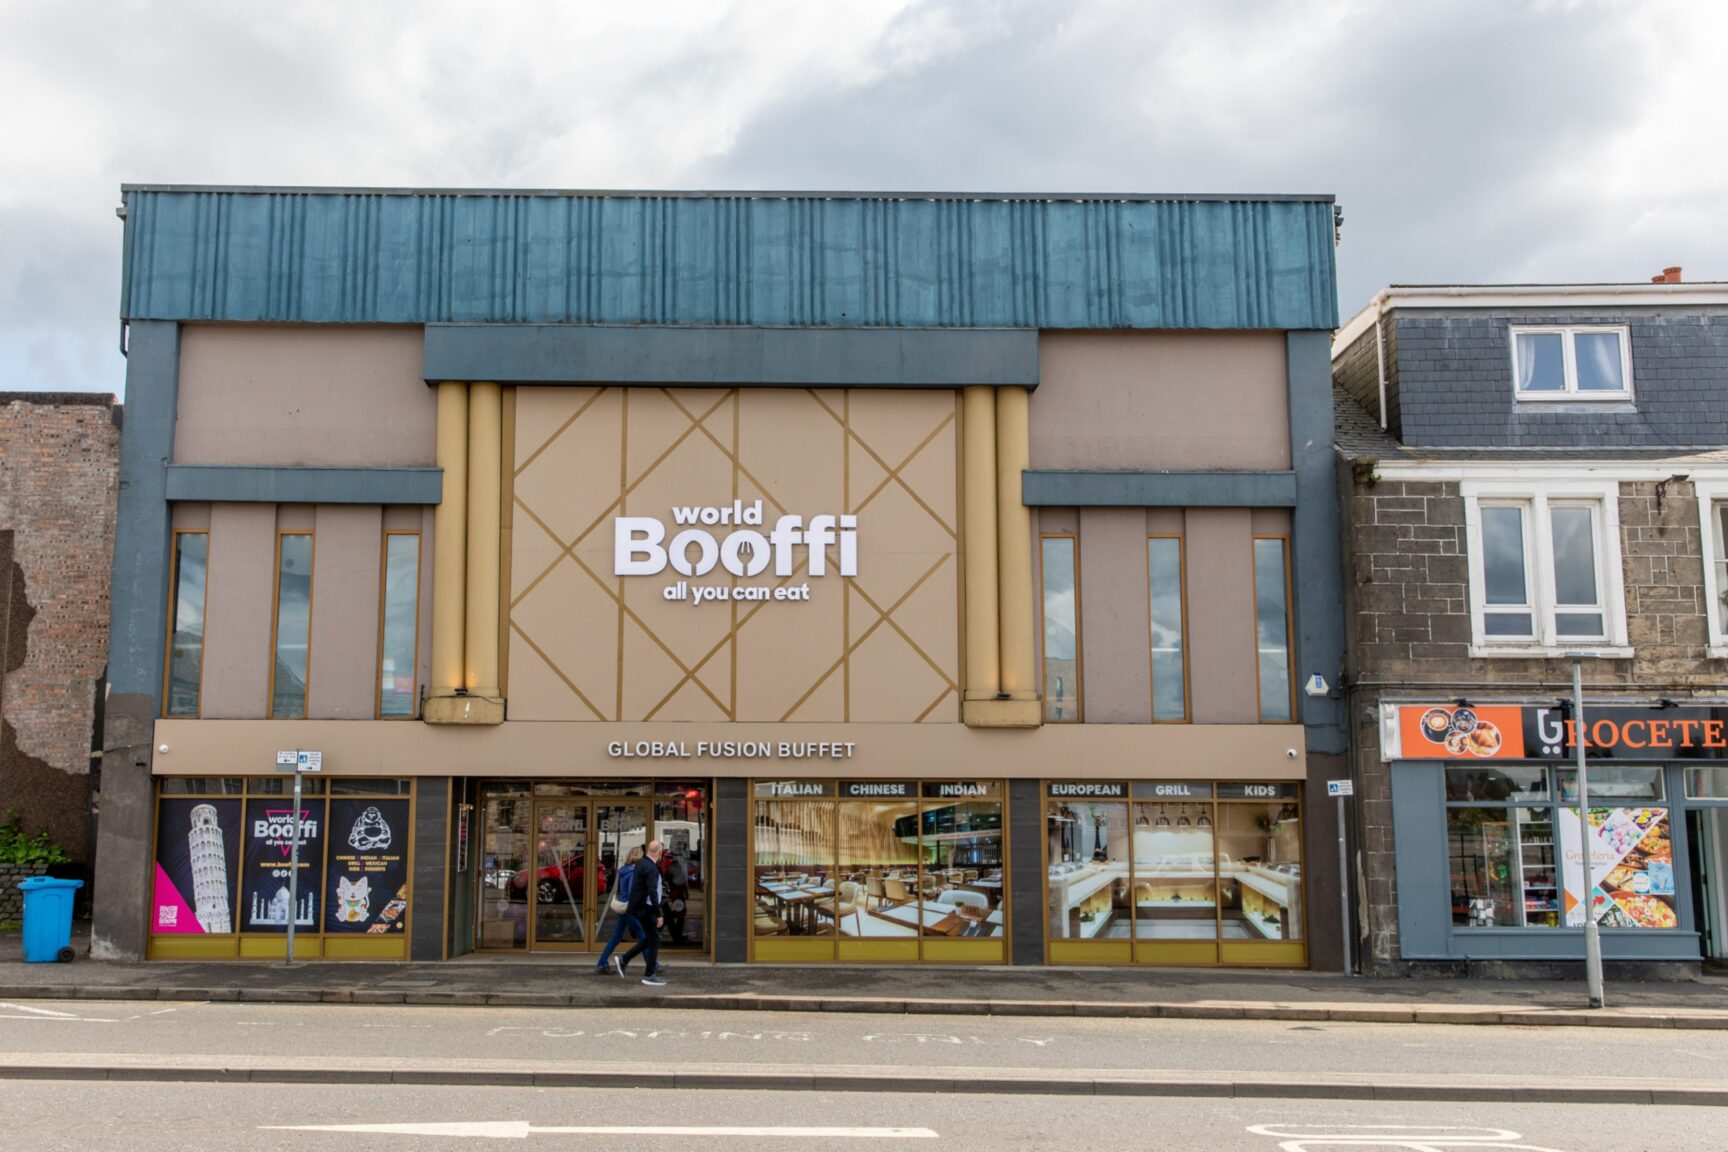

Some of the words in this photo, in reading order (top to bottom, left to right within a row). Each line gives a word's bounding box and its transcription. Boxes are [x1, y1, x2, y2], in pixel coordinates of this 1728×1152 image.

[672, 500, 763, 525] world
[614, 514, 857, 577] Booffi
[663, 581, 687, 600] all
[692, 585, 729, 606] you
[732, 585, 771, 601] can
[774, 582, 810, 601] eat
[607, 741, 691, 757] GLOBAL
[697, 742, 771, 757] FUSION
[778, 742, 855, 758] BUFFET
[771, 784, 823, 795] ITALIAN
[850, 784, 905, 795] CHINESE
[940, 784, 987, 796] INDIAN
[1052, 784, 1121, 795] EUROPEAN
[1155, 785, 1191, 796] GRILL
[1244, 785, 1276, 796] KIDS
